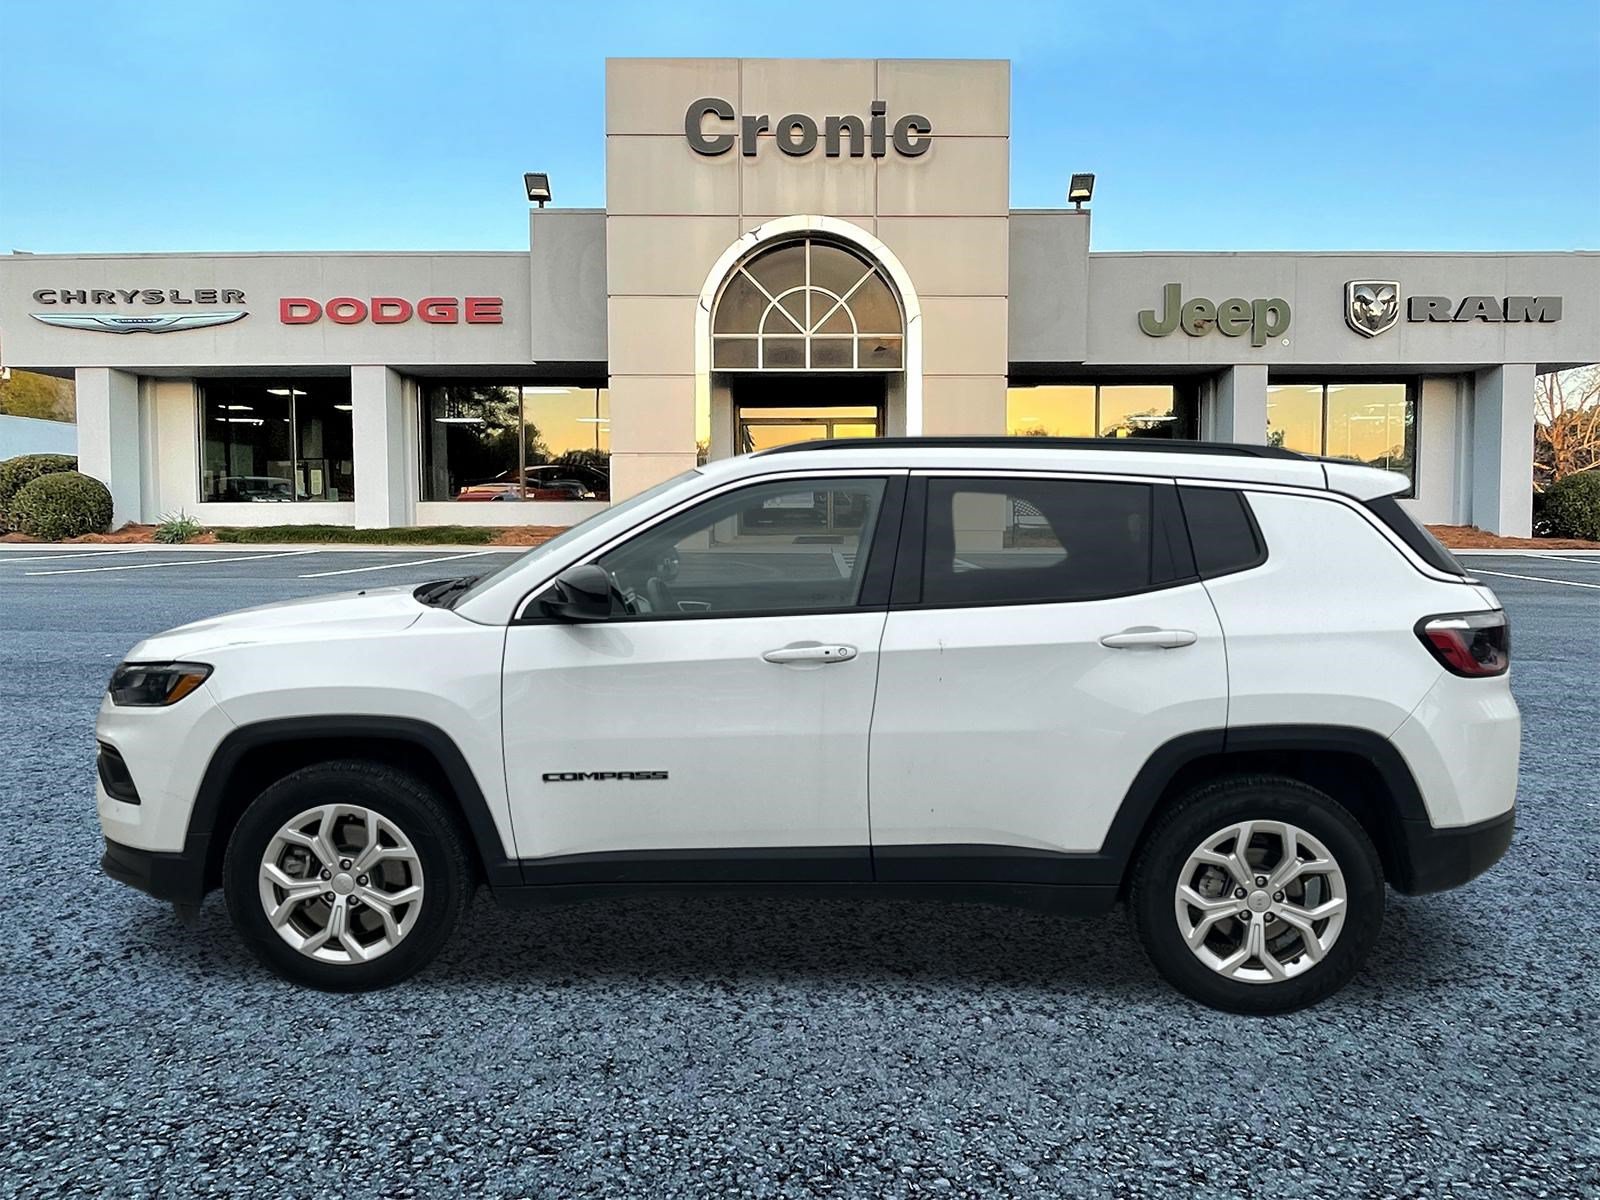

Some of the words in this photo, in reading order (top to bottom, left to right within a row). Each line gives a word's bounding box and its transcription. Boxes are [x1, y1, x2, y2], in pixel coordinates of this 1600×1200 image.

[685, 97, 932, 158] Cronic
[32, 288, 246, 305] CHRYSLER
[1407, 296, 1563, 323] RAM
[279, 297, 503, 325] DODGE
[1138, 282, 1292, 347] Jeep
[542, 770, 669, 782] COMPASS
